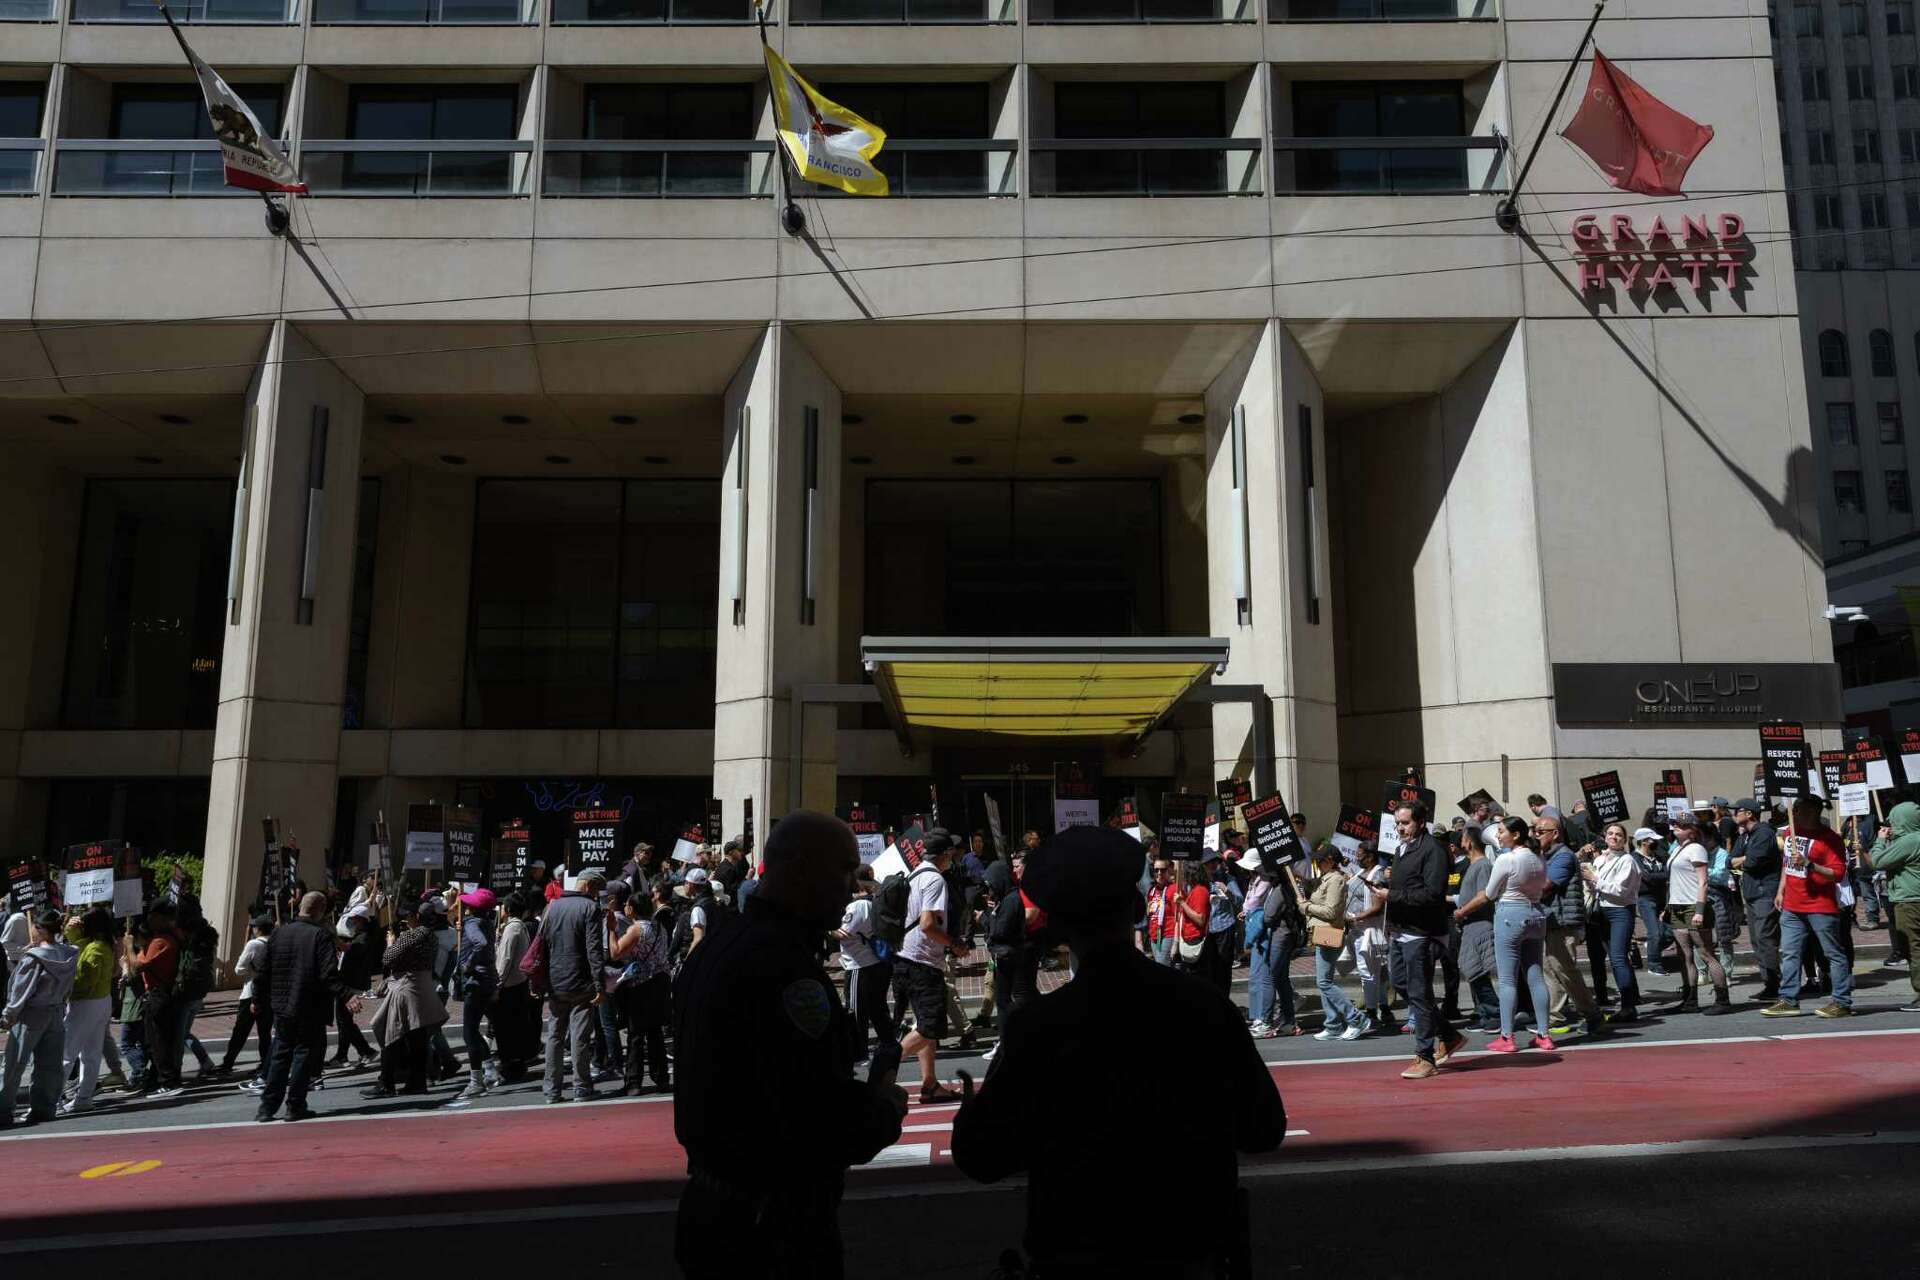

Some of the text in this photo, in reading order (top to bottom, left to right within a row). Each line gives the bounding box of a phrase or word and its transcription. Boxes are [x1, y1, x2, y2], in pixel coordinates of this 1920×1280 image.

[807, 153, 862, 177] RANCISCO
[1571, 213, 1746, 242] GRAND
[1578, 261, 1743, 291] HYATT
[1767, 750, 1802, 759] RESPECT
[1777, 760, 1796, 769] OUR
[1773, 769, 1802, 779] WORK.
[1401, 789, 1418, 800] ON
[1591, 787, 1617, 800] MAKE
[1245, 795, 1281, 818] ON STRIKE
[1592, 796, 1619, 808] THEM
[575, 810, 621, 820] ON STRIKE
[849, 821, 880, 832] TRIKE
[1257, 818, 1285, 835] ONE JOB
[1342, 820, 1378, 840] STRIKE
[449, 830, 474, 842] MAKE
[579, 828, 615, 839] MAKE
[1257, 829, 1283, 845] SHOULD
[86, 845, 104, 856] ON
[449, 842, 475, 855] THEM
[578, 840, 615, 850] THEM
[74, 855, 113, 869] STRIKE
[582, 850, 611, 862] PAY.
